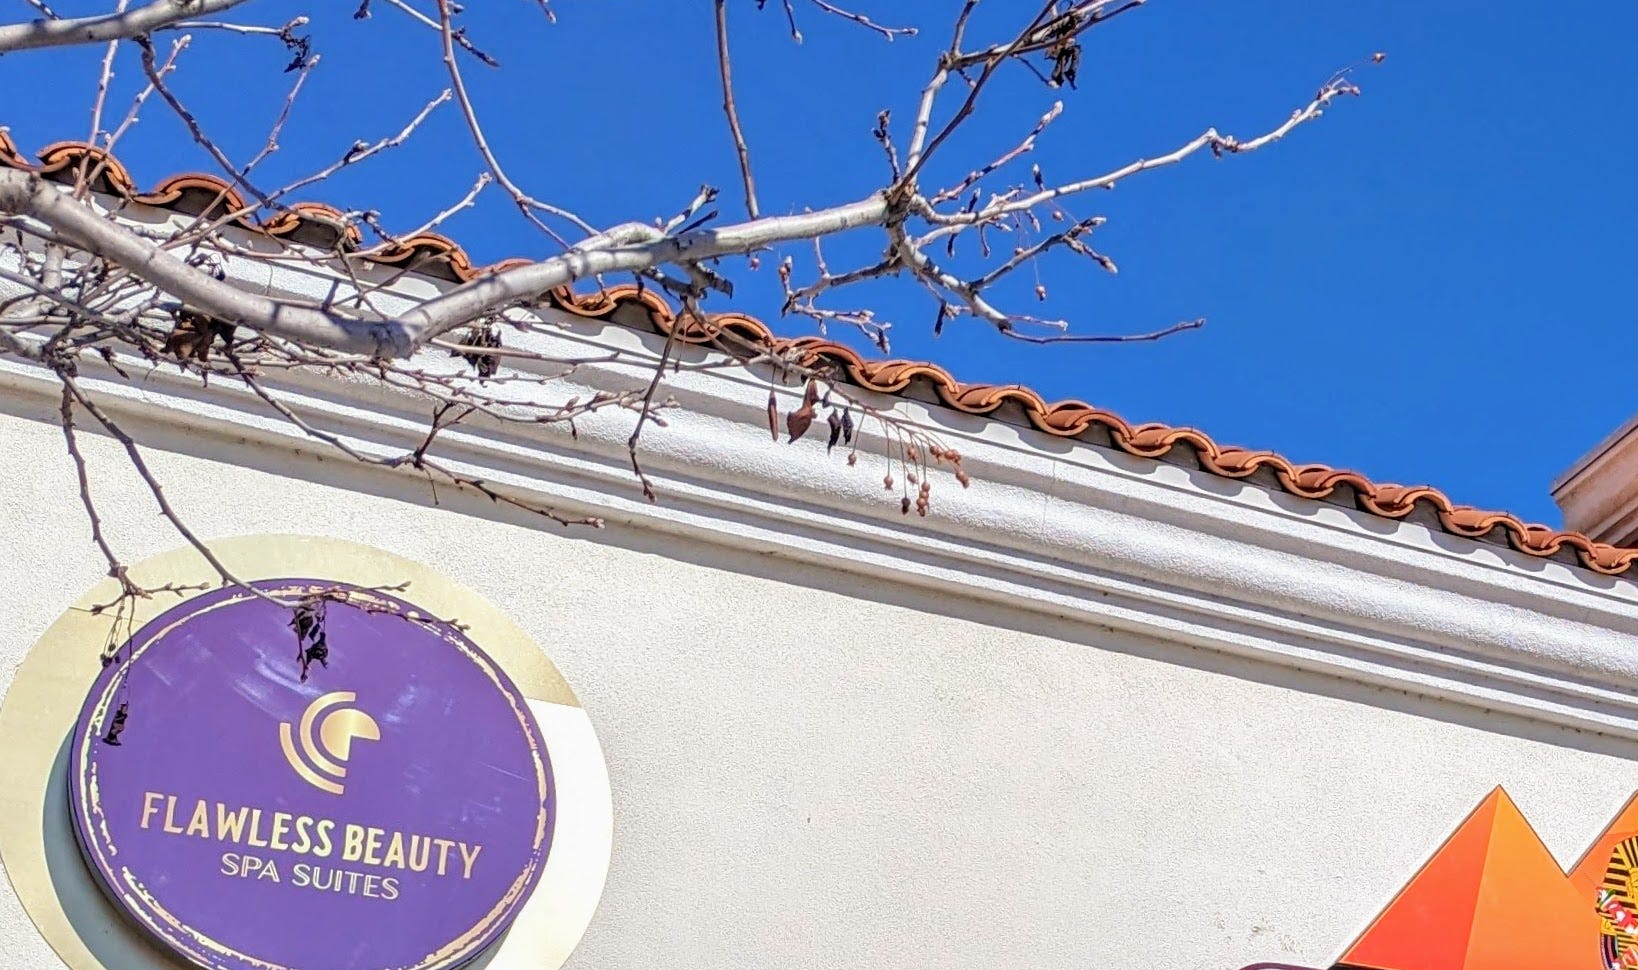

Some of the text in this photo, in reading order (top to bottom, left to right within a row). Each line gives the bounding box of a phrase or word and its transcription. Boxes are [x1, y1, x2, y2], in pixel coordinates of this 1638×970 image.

[140, 791, 483, 880] FLAWLESS BEAUTY
[220, 852, 400, 900] SPA SUITES
